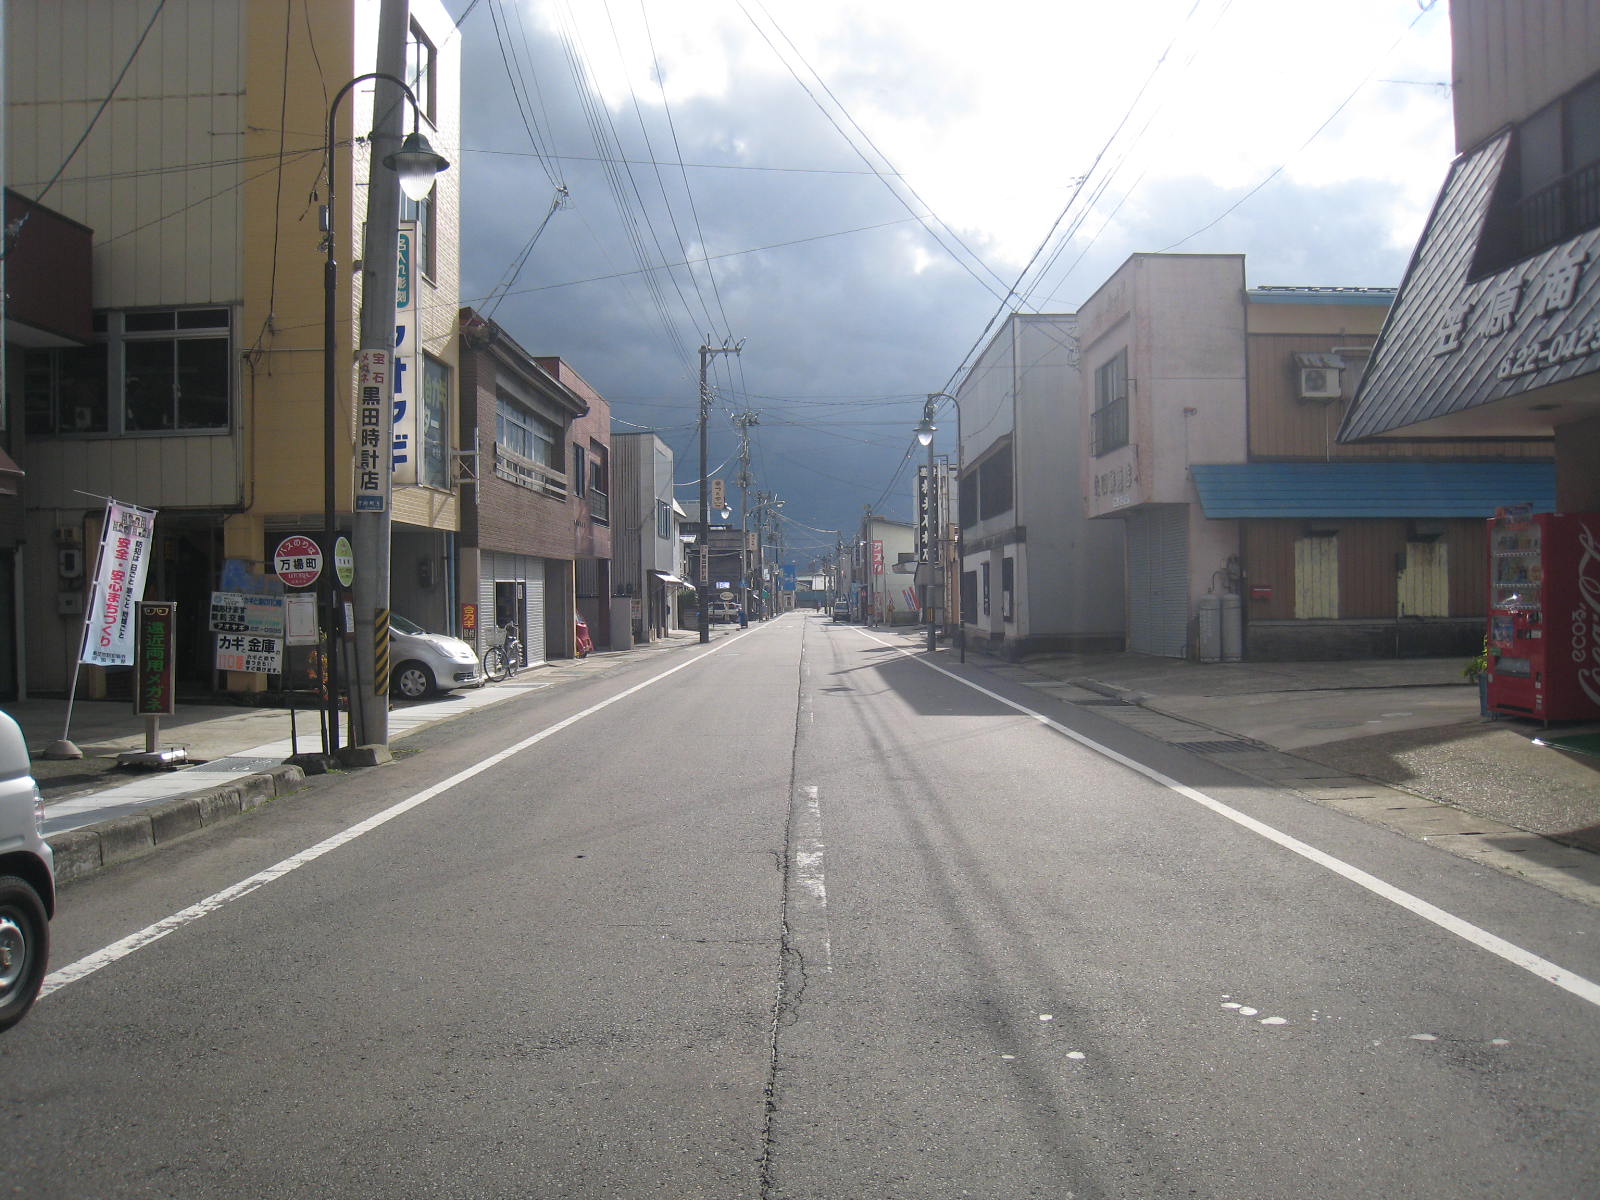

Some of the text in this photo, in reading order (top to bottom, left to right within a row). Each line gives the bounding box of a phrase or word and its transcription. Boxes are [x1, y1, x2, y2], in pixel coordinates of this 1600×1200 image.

[372, 353, 385, 384] 宝石
[360, 386, 381, 491] 黒田時計店
[100, 537, 131, 648] 安全・安心まちづくり
[144, 620, 166, 710] 遠近両用メガネ
